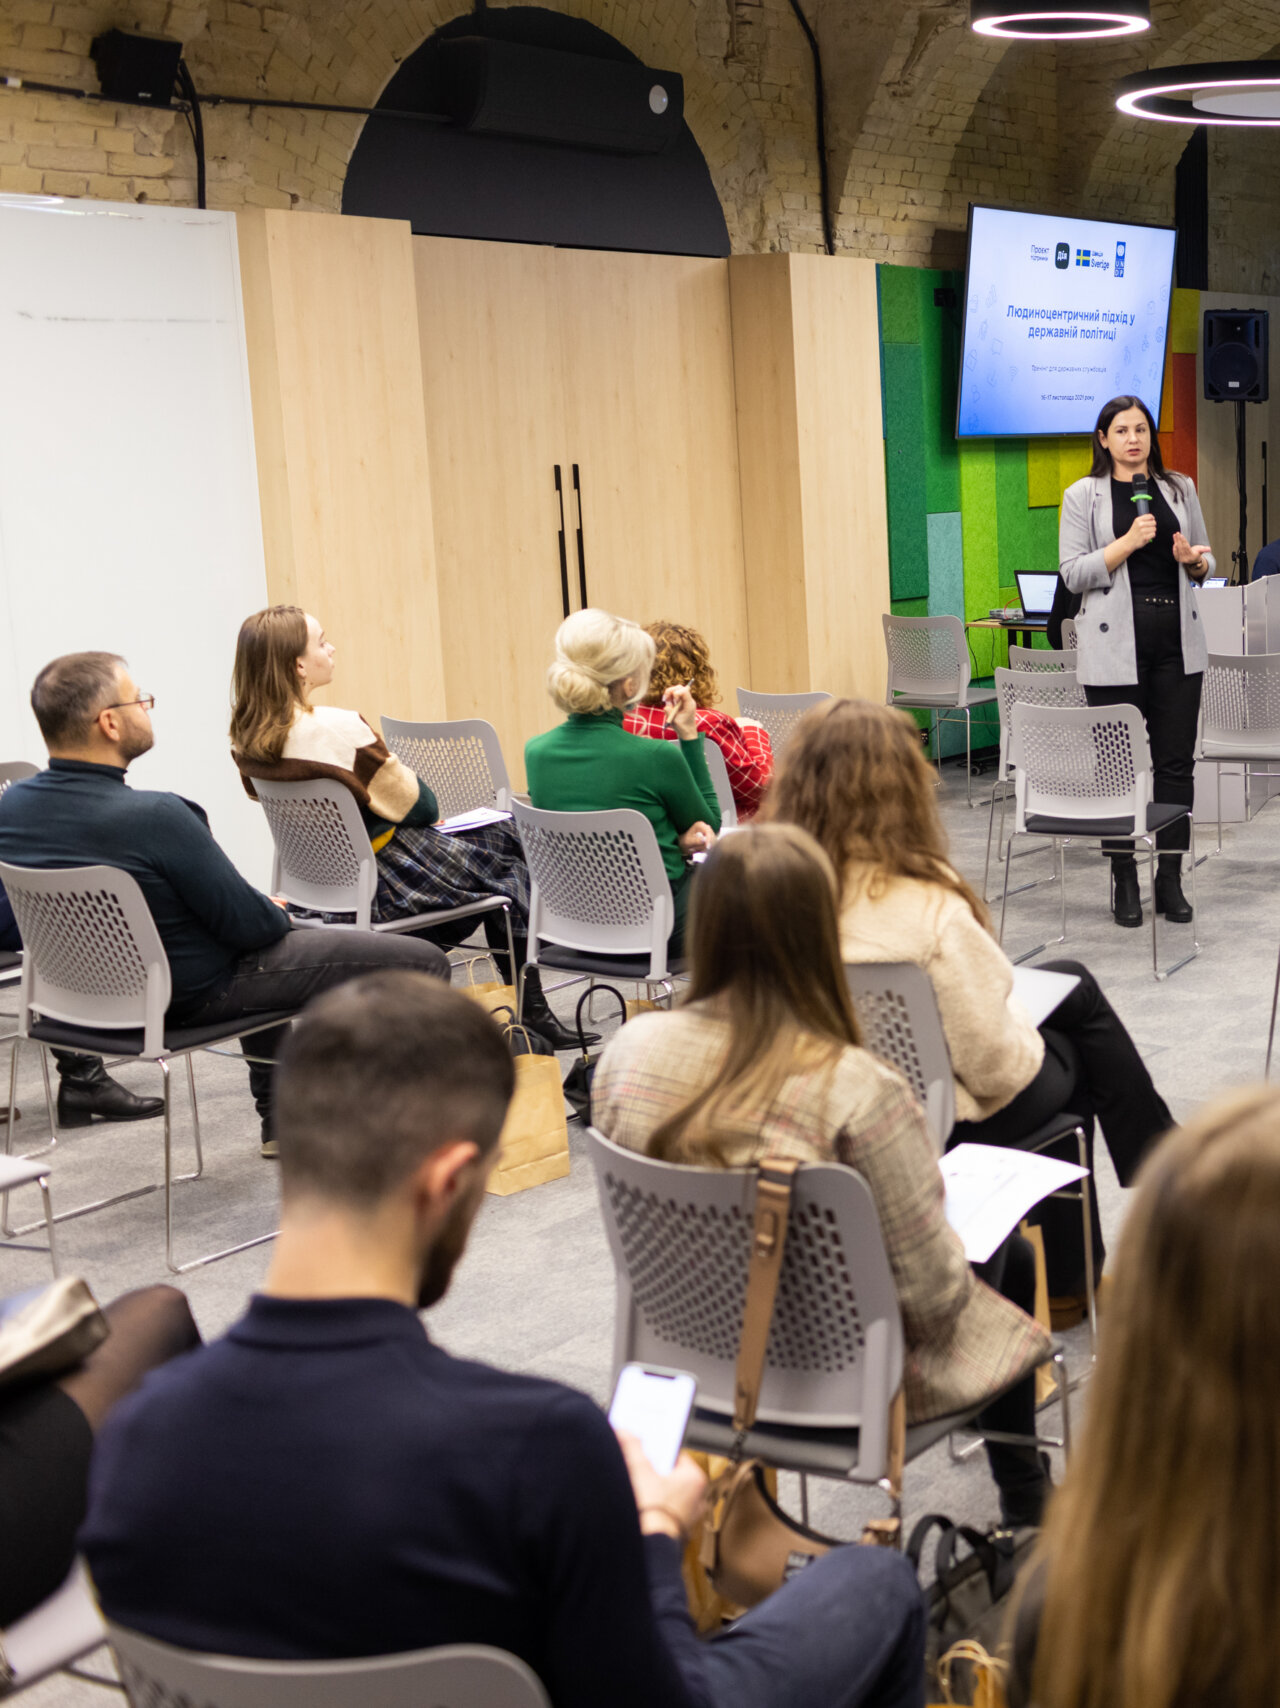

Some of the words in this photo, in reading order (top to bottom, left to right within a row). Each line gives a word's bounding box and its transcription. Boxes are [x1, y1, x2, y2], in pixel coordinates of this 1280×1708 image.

[1007, 305, 1100, 322] Людиноцентричний
[1102, 310, 1128, 325] підхід
[1129, 313, 1136, 326] у
[1028, 325, 1078, 340] державній
[1080, 327, 1116, 341] політиці
